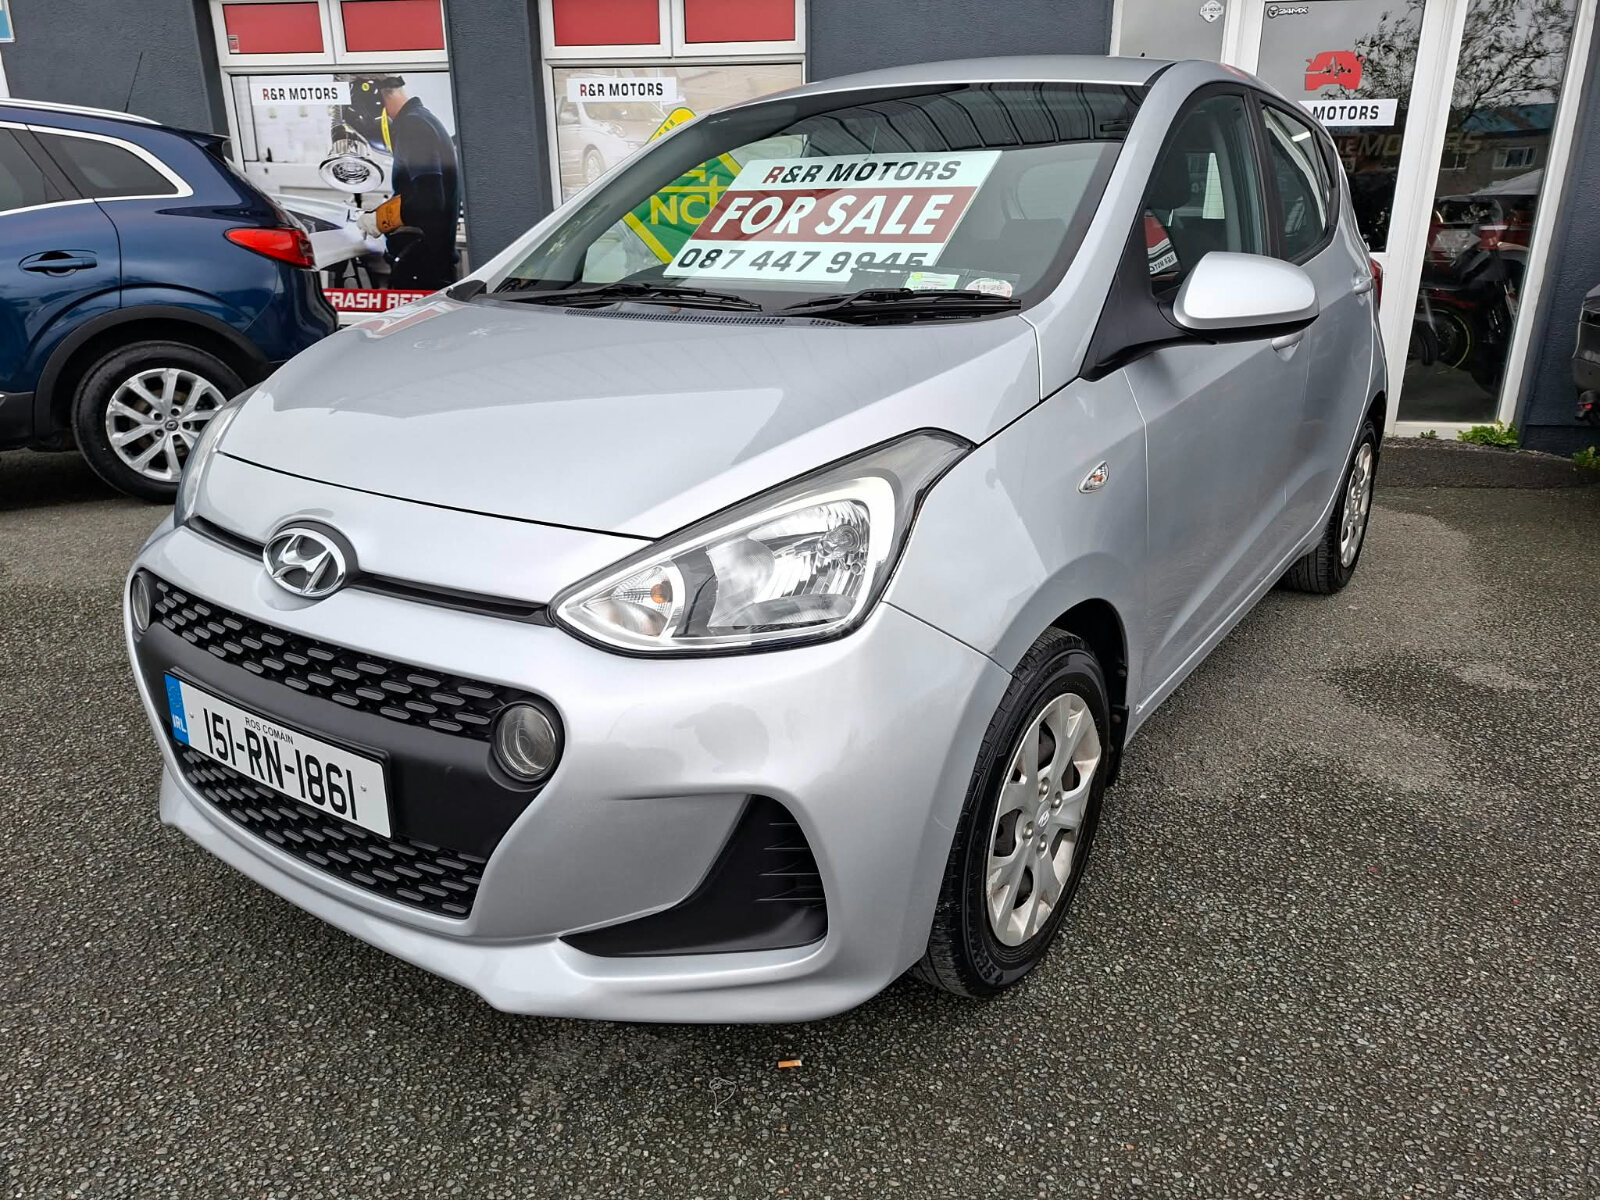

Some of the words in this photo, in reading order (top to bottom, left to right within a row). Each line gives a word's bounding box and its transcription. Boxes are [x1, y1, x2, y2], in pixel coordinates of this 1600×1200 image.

[262, 88, 286, 101] R&R
[289, 87, 339, 100] MOTORS
[580, 83, 605, 97] R&R
[609, 82, 664, 96] MOTORS
[1312, 105, 1380, 121] MOTORS
[762, 164, 821, 185] R&R
[825, 160, 962, 182] MOTORS
[710, 195, 818, 236] FOR
[815, 193, 954, 235] SALE
[677, 248, 746, 270] 087
[749, 250, 821, 272] 447
[172, 714, 187, 733] IRL
[244, 716, 261, 731] ROS
[203, 707, 358, 821] 151-RN-1861
